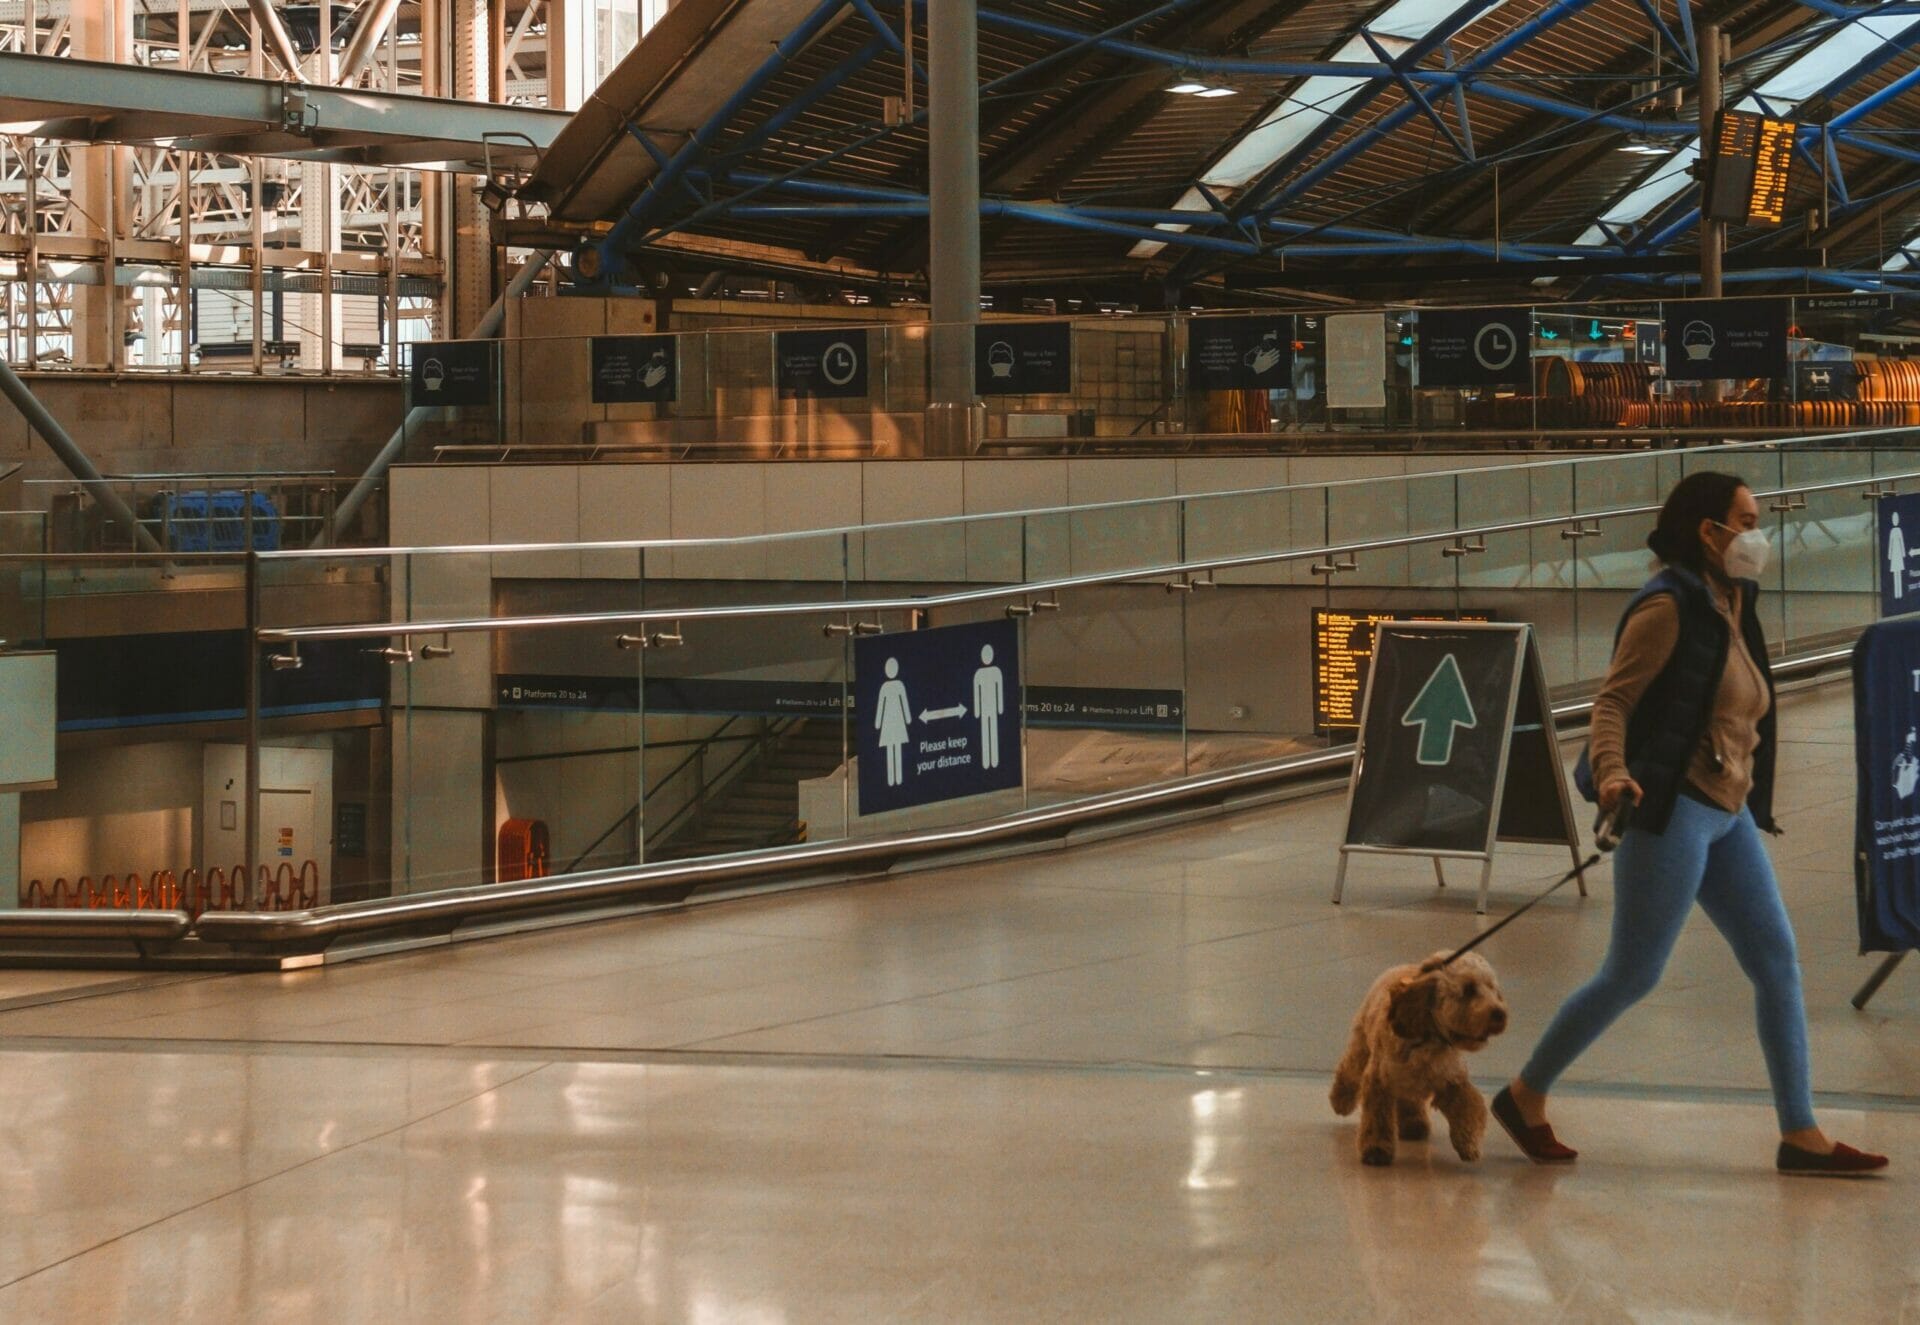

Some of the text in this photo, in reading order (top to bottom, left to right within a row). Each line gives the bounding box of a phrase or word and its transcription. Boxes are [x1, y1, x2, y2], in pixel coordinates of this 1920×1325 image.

[523, 688, 587, 699] Platforms 20 to 24
[828, 696, 841, 707] Lift
[1040, 702, 1052, 712] 20
[1053, 703, 1063, 713] to
[1064, 703, 1076, 713] 24
[1089, 706, 1114, 715] Platforms
[1139, 705, 1154, 716] Lift
[919, 736, 968, 754] Please keep
[916, 753, 972, 776] your distance
